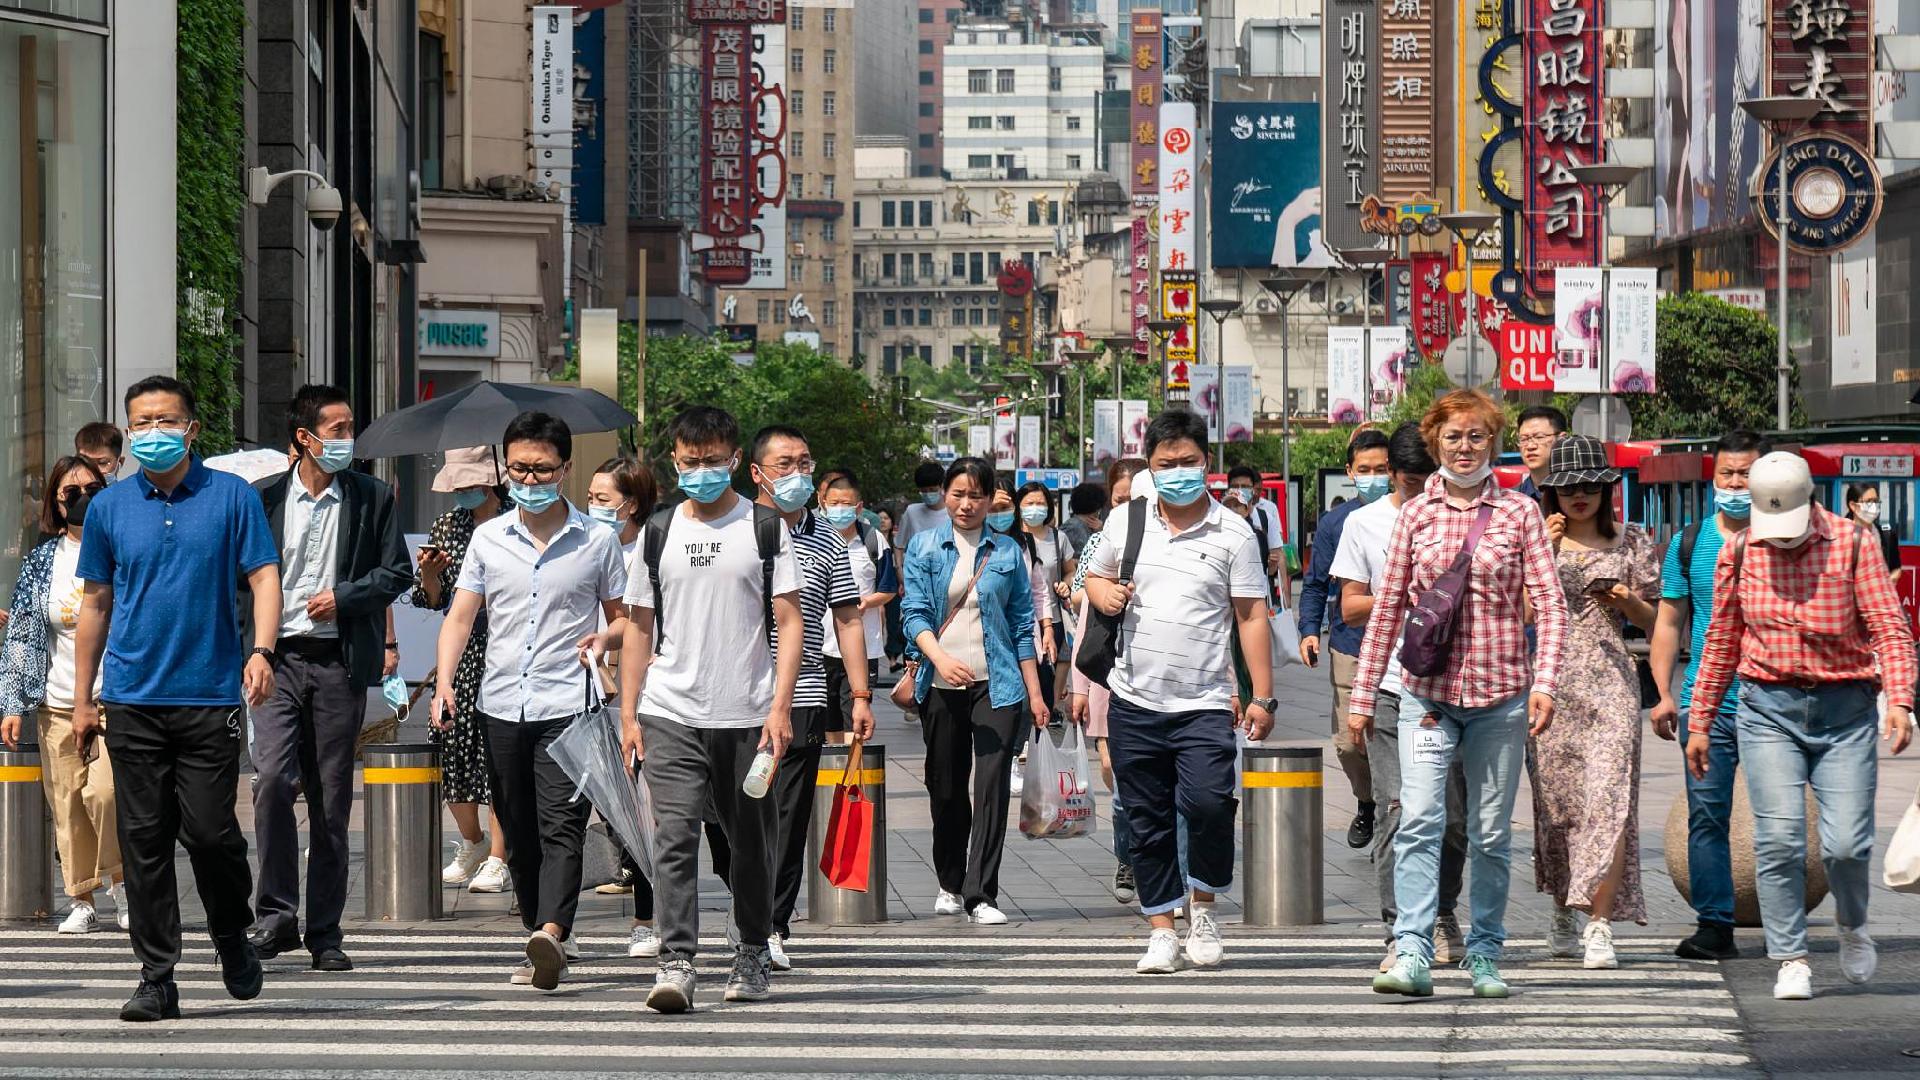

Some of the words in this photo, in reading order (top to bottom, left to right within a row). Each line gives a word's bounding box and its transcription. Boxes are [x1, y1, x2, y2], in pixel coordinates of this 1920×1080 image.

[758, 0, 783, 19] 9F
[541, 39, 553, 70] Tiger
[541, 71, 551, 124] Onitsuka
[1878, 71, 1908, 106] OMEGA
[1339, 11, 1368, 206] 明牌珠宝
[711, 27, 743, 233] 茂昌眼镜验配中心
[1827, 144, 1864, 179] DALI
[1801, 227, 1824, 240] AND
[1829, 188, 1868, 237] WATCHES
[690, 555, 716, 568] RIGHT
